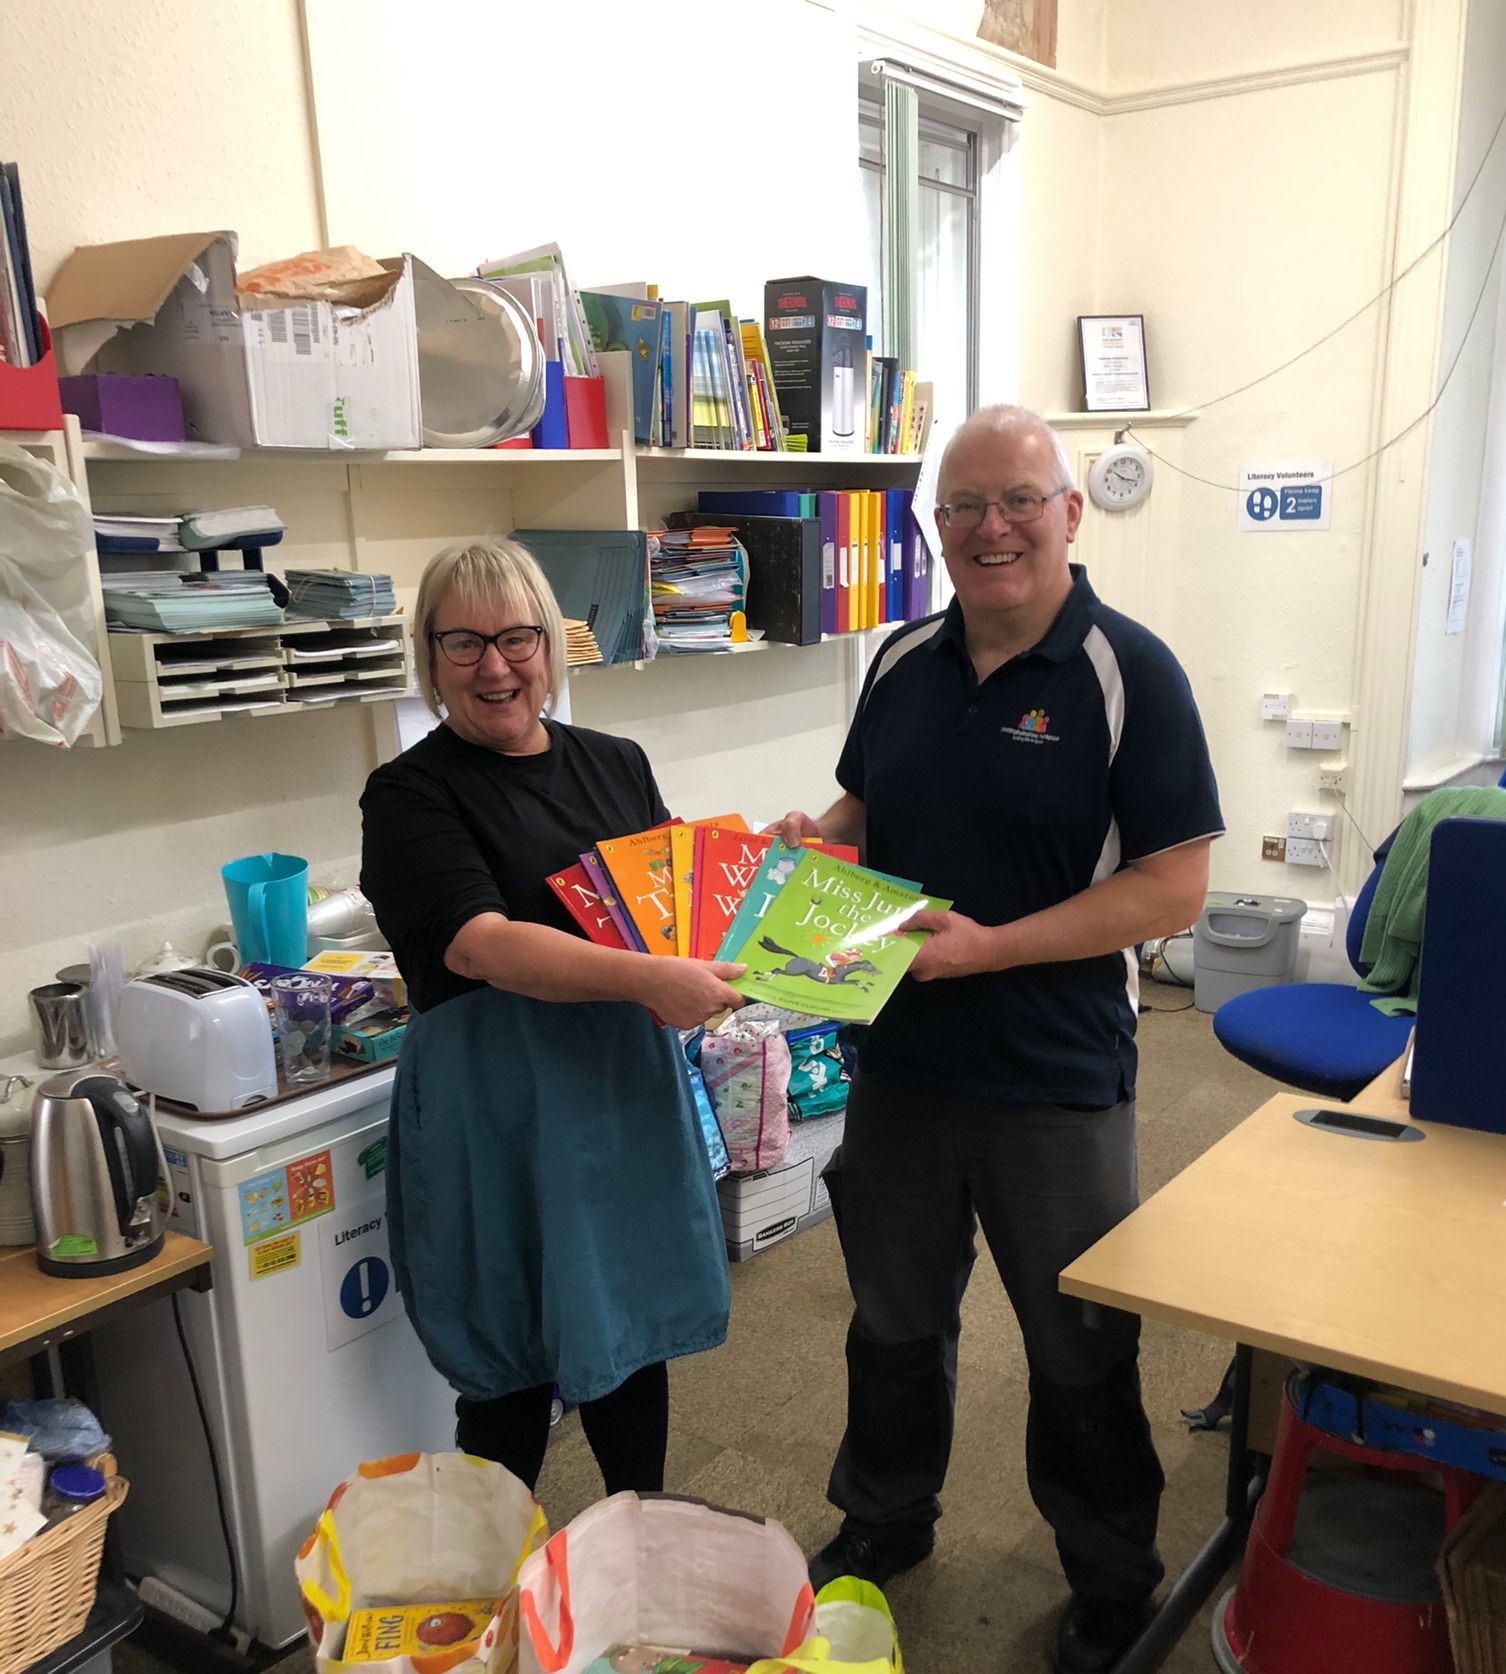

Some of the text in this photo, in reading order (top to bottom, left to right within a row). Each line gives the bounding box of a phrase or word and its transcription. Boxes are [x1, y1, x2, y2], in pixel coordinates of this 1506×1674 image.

[1247, 471, 1314, 481] Literacy Volunteers
[1285, 497, 1296, 513] 2
[802, 867, 862, 904] Miss
[833, 864, 872, 887] Ahlberg
[838, 904, 872, 924] the
[334, 1217, 383, 1246] Literacy
[374, 1614, 405, 1651] FING
